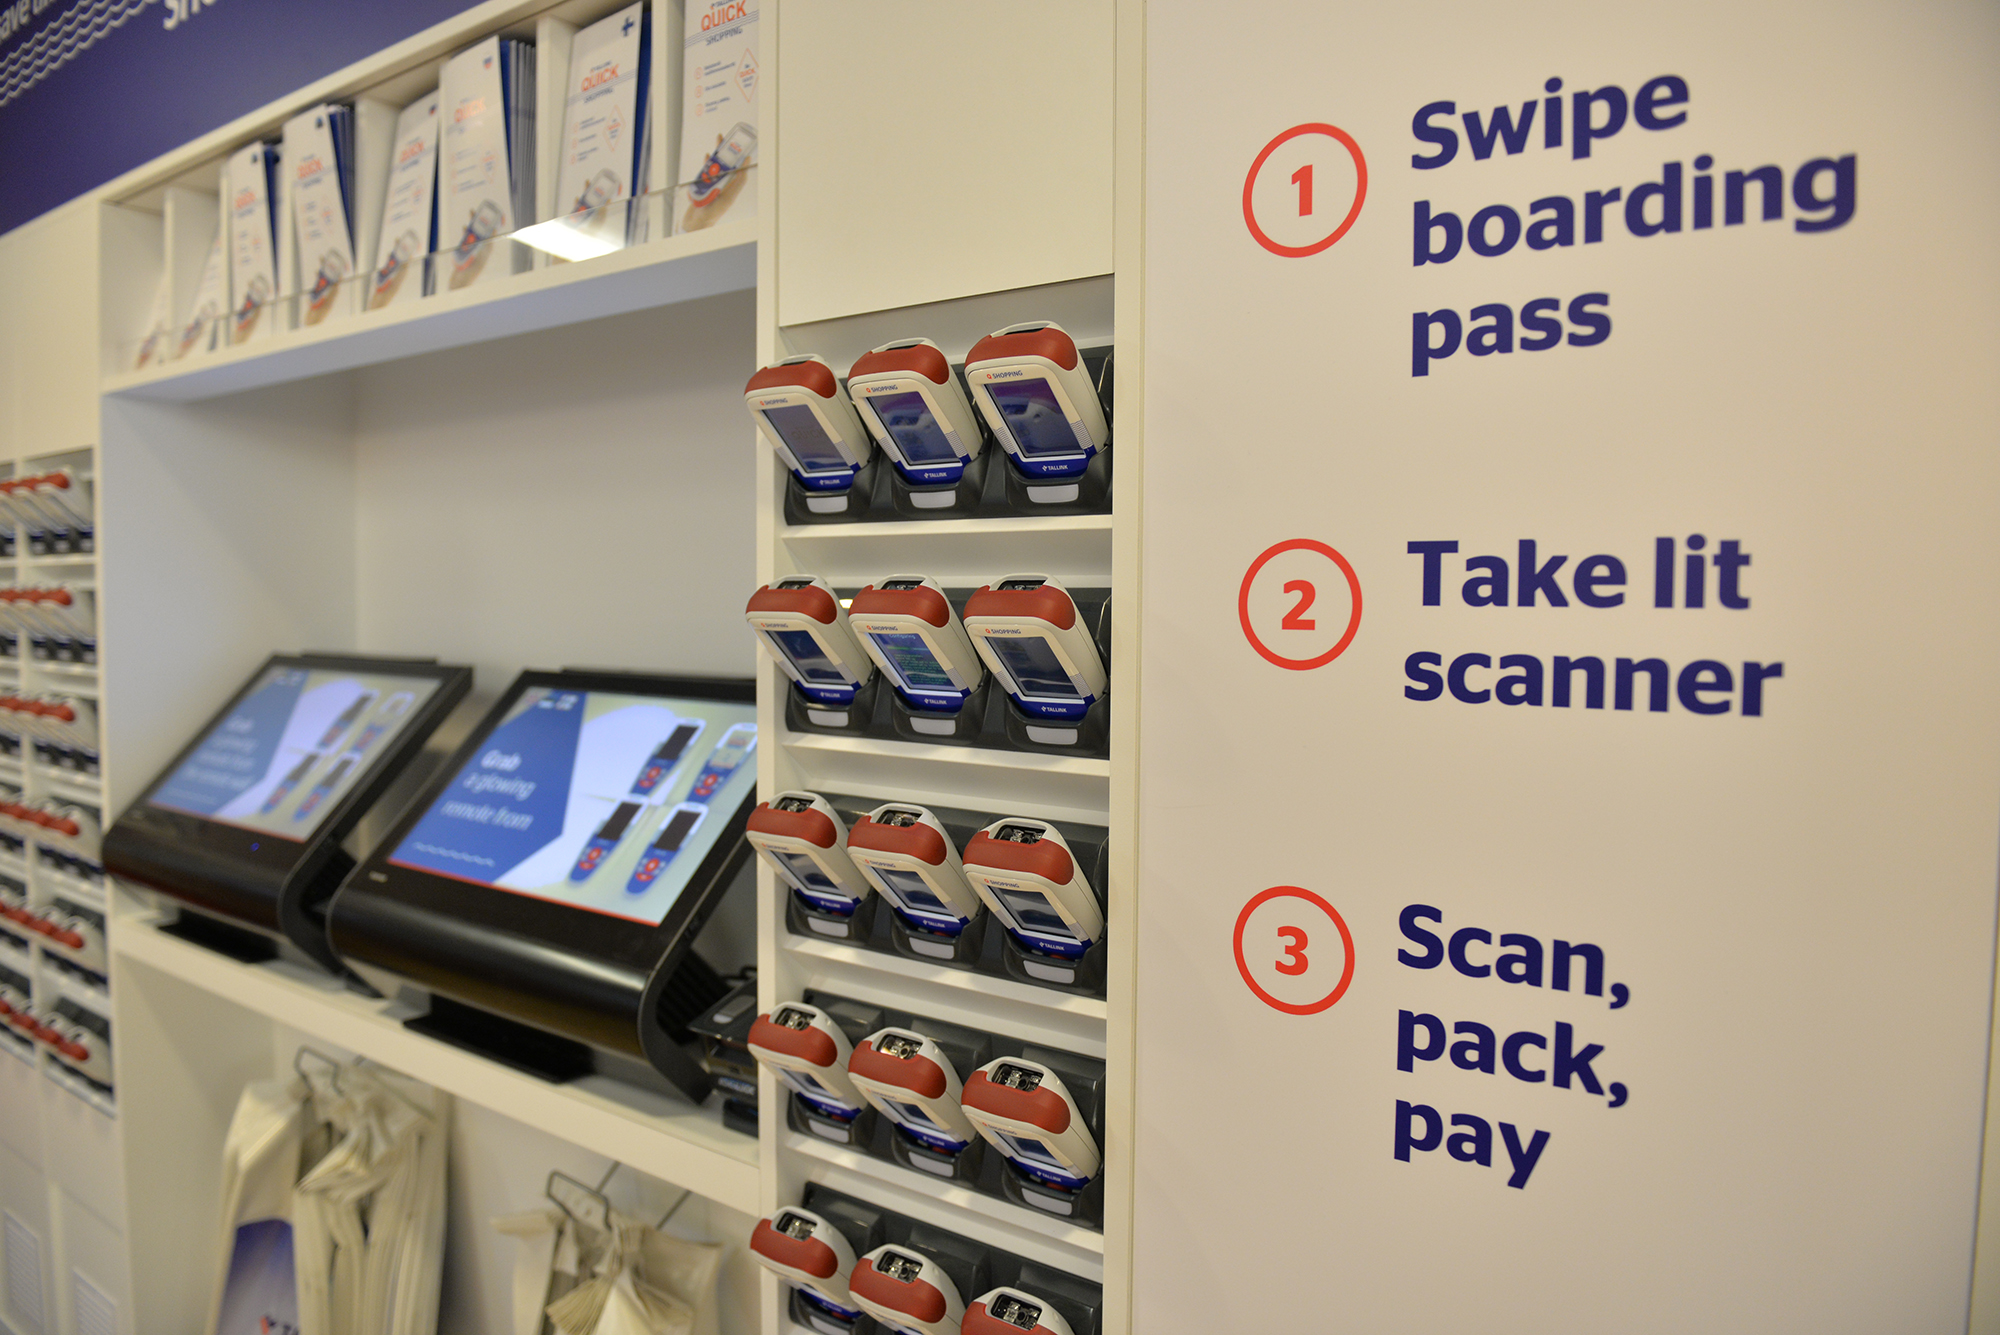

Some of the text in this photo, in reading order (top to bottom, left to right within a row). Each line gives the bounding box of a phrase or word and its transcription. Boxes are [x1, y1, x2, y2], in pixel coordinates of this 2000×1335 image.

[701, 0, 747, 31] QUICK
[581, 64, 620, 92] QUICK
[1411, 76, 1689, 170] Swipe
[1291, 164, 1314, 217] 1
[1413, 155, 1855, 267] boarding
[1412, 292, 1611, 378] pass
[871, 384, 899, 393] SHOPPING
[992, 370, 1024, 380] SHOPPING
[1407, 534, 1750, 610] Take lit
[1281, 579, 1317, 631] 2
[1046, 705, 1068, 713] TALLINK
[1404, 651, 1784, 717] scanner
[480, 749, 522, 773] Grab
[472, 774, 537, 801] glowing
[490, 805, 534, 832] from
[1043, 942, 1066, 952] TALLINK
[1275, 925, 1309, 976] 3
[1397, 904, 1630, 1010] Scan,
[1397, 1009, 1629, 1108] pack,
[1394, 1099, 1551, 1190] pay
